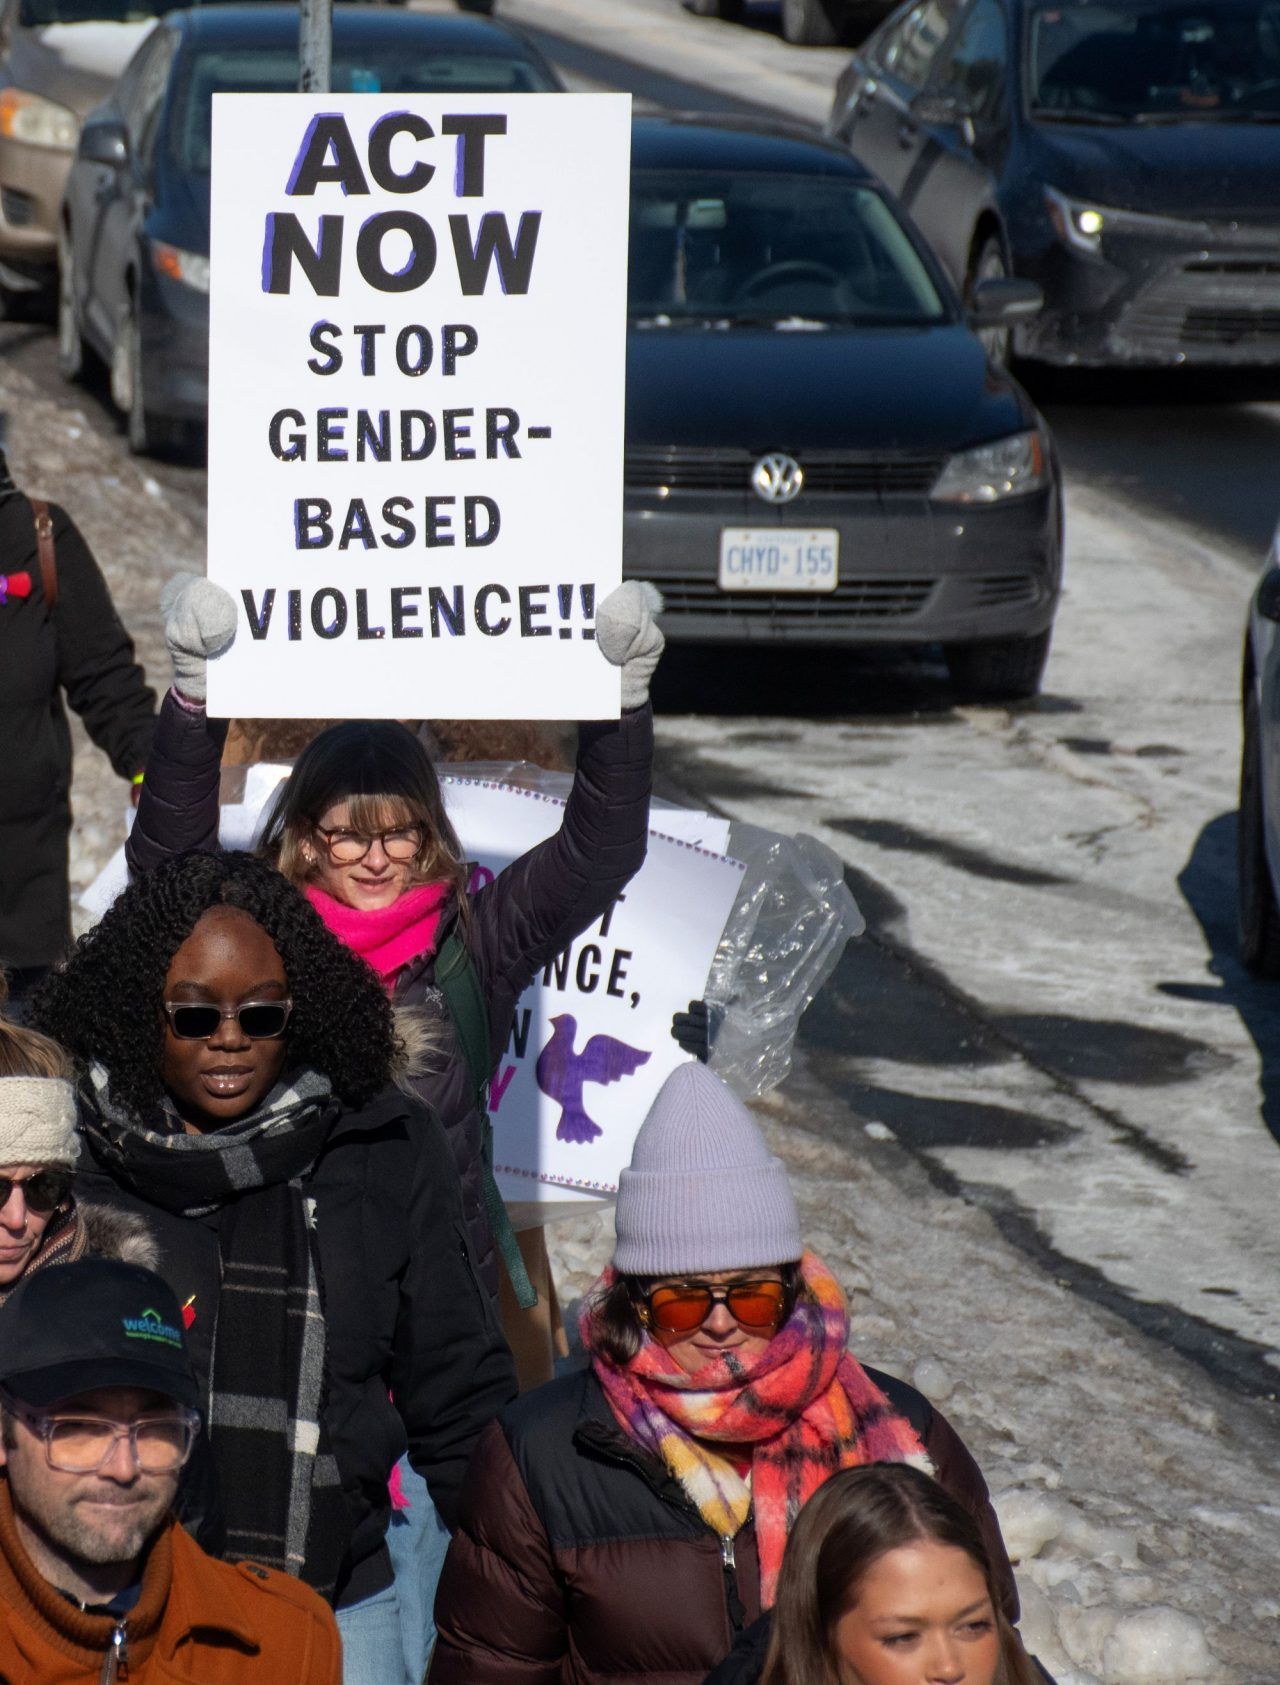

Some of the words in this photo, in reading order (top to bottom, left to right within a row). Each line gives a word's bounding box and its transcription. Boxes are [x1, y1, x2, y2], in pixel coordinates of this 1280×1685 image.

[285, 111, 508, 198] ACT
[261, 210, 543, 297] NOW
[307, 319, 479, 378] STOP
[268, 407, 552, 463] GENDER-
[293, 495, 501, 551] BASED
[240, 583, 596, 641] VIOLENCE!!
[531, 944, 641, 1010] NCE,
[122, 1317, 181, 1341] welcome
